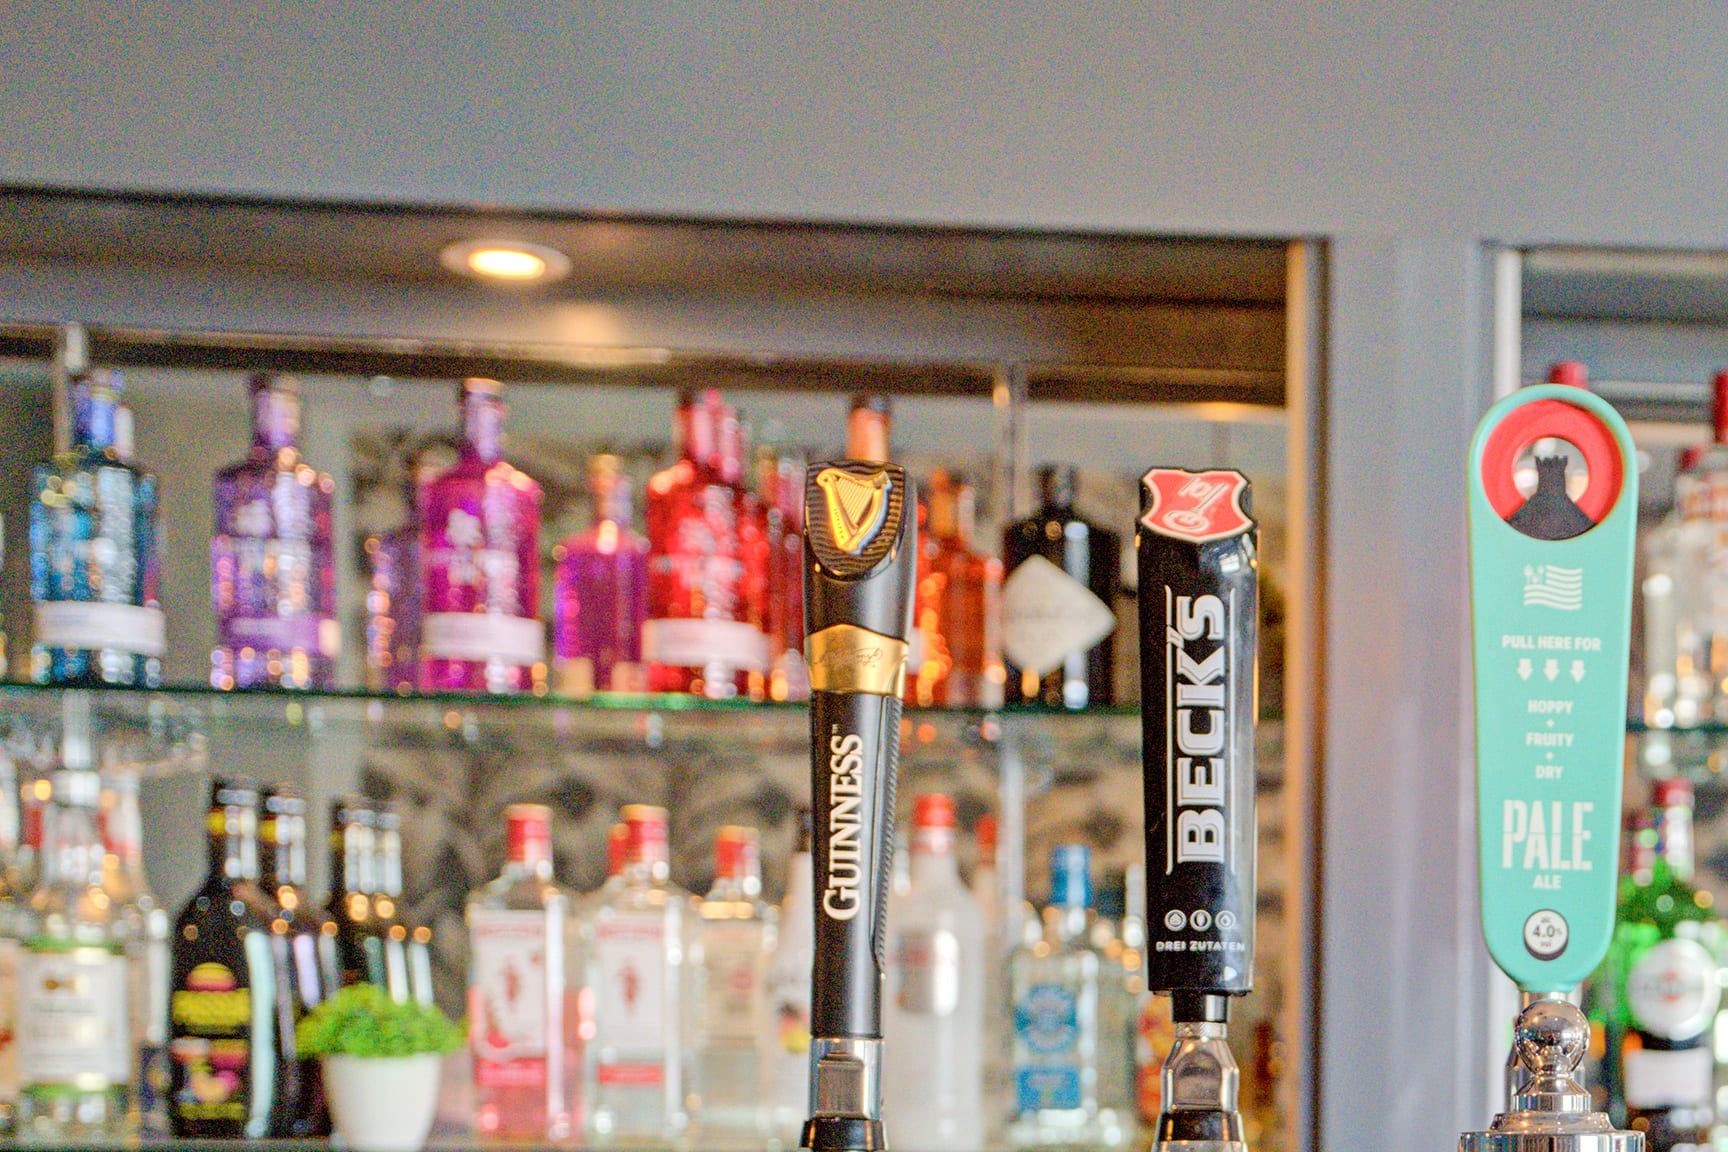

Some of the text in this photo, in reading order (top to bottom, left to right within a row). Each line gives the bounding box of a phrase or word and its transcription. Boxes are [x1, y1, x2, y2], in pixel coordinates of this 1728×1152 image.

[1501, 634, 1602, 651] PULL HERE FOR
[1527, 699, 1574, 714] HOPPY
[1167, 594, 1225, 864] BECK'S
[1525, 732, 1575, 747] FRUITY
[1535, 765, 1564, 779] DRY
[823, 733, 863, 921] GUINNESS
[1502, 799, 1594, 871] PALE
[1533, 874, 1562, 889] ALE
[1156, 940, 1246, 953] DREI ZUTATEN
